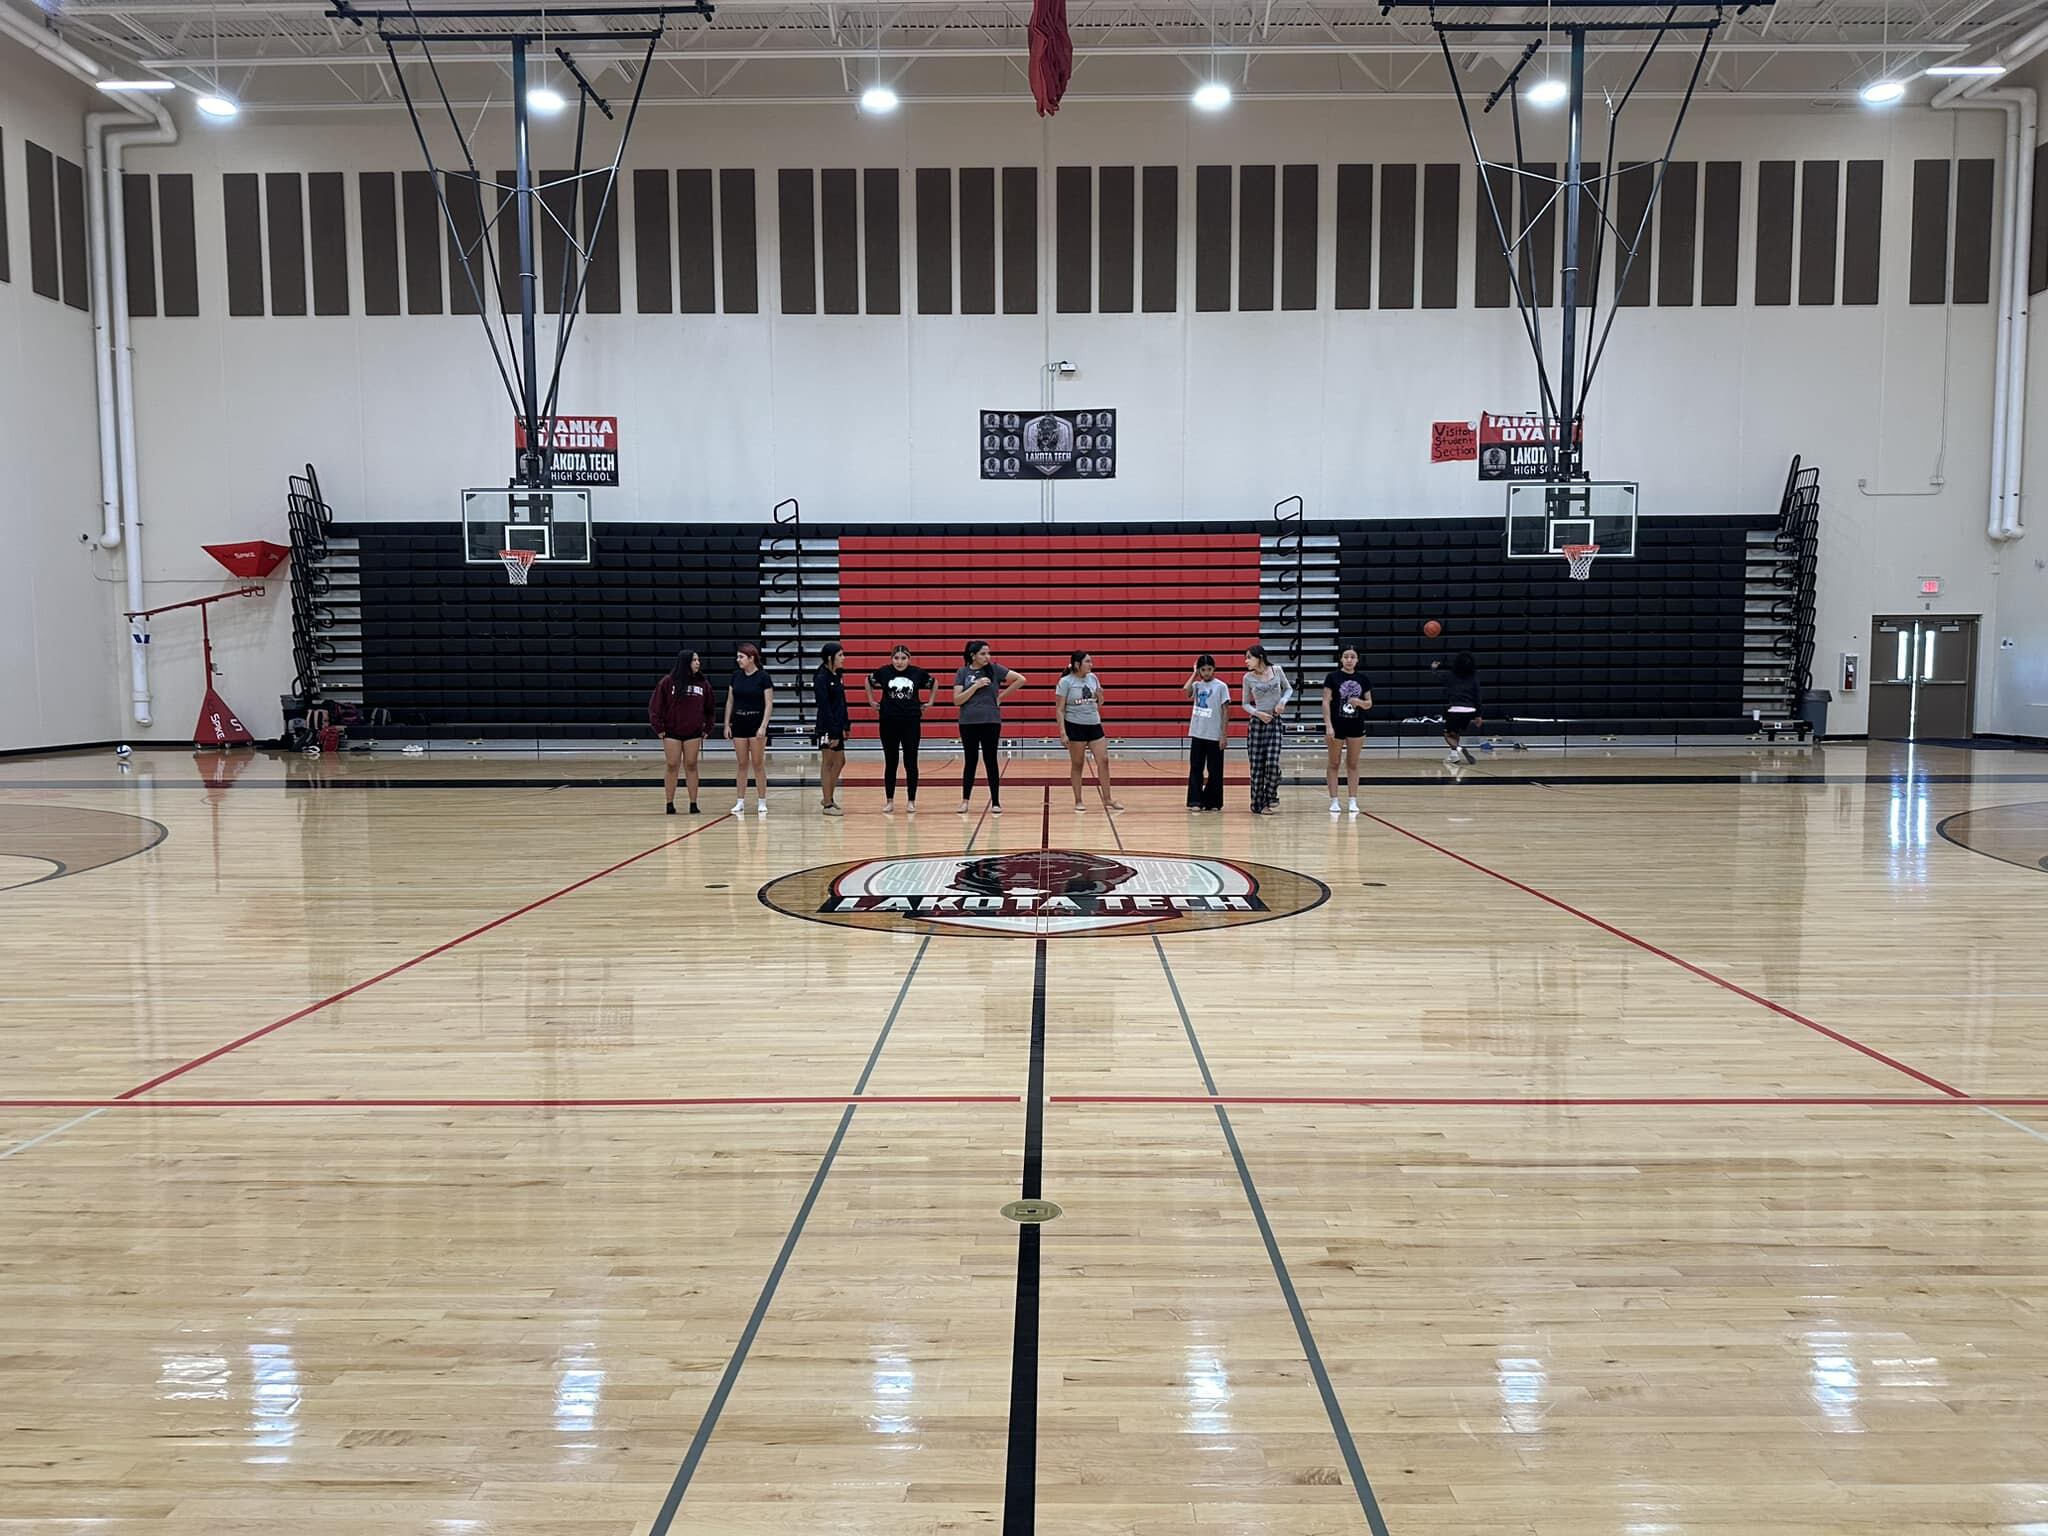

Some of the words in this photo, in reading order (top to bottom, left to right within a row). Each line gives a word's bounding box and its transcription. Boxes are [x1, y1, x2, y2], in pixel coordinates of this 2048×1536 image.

[1502, 427, 1560, 441] OYAT
[549, 453, 587, 471] AKOTA
[589, 453, 615, 471] TECH
[1054, 452, 1072, 462] TECH
[551, 471, 573, 481] HIGH
[576, 471, 612, 481] SCHOOL
[1513, 466, 1537, 475] HIGH
[834, 896, 1082, 911] LAKOTA
[1096, 896, 1253, 911] TECH
